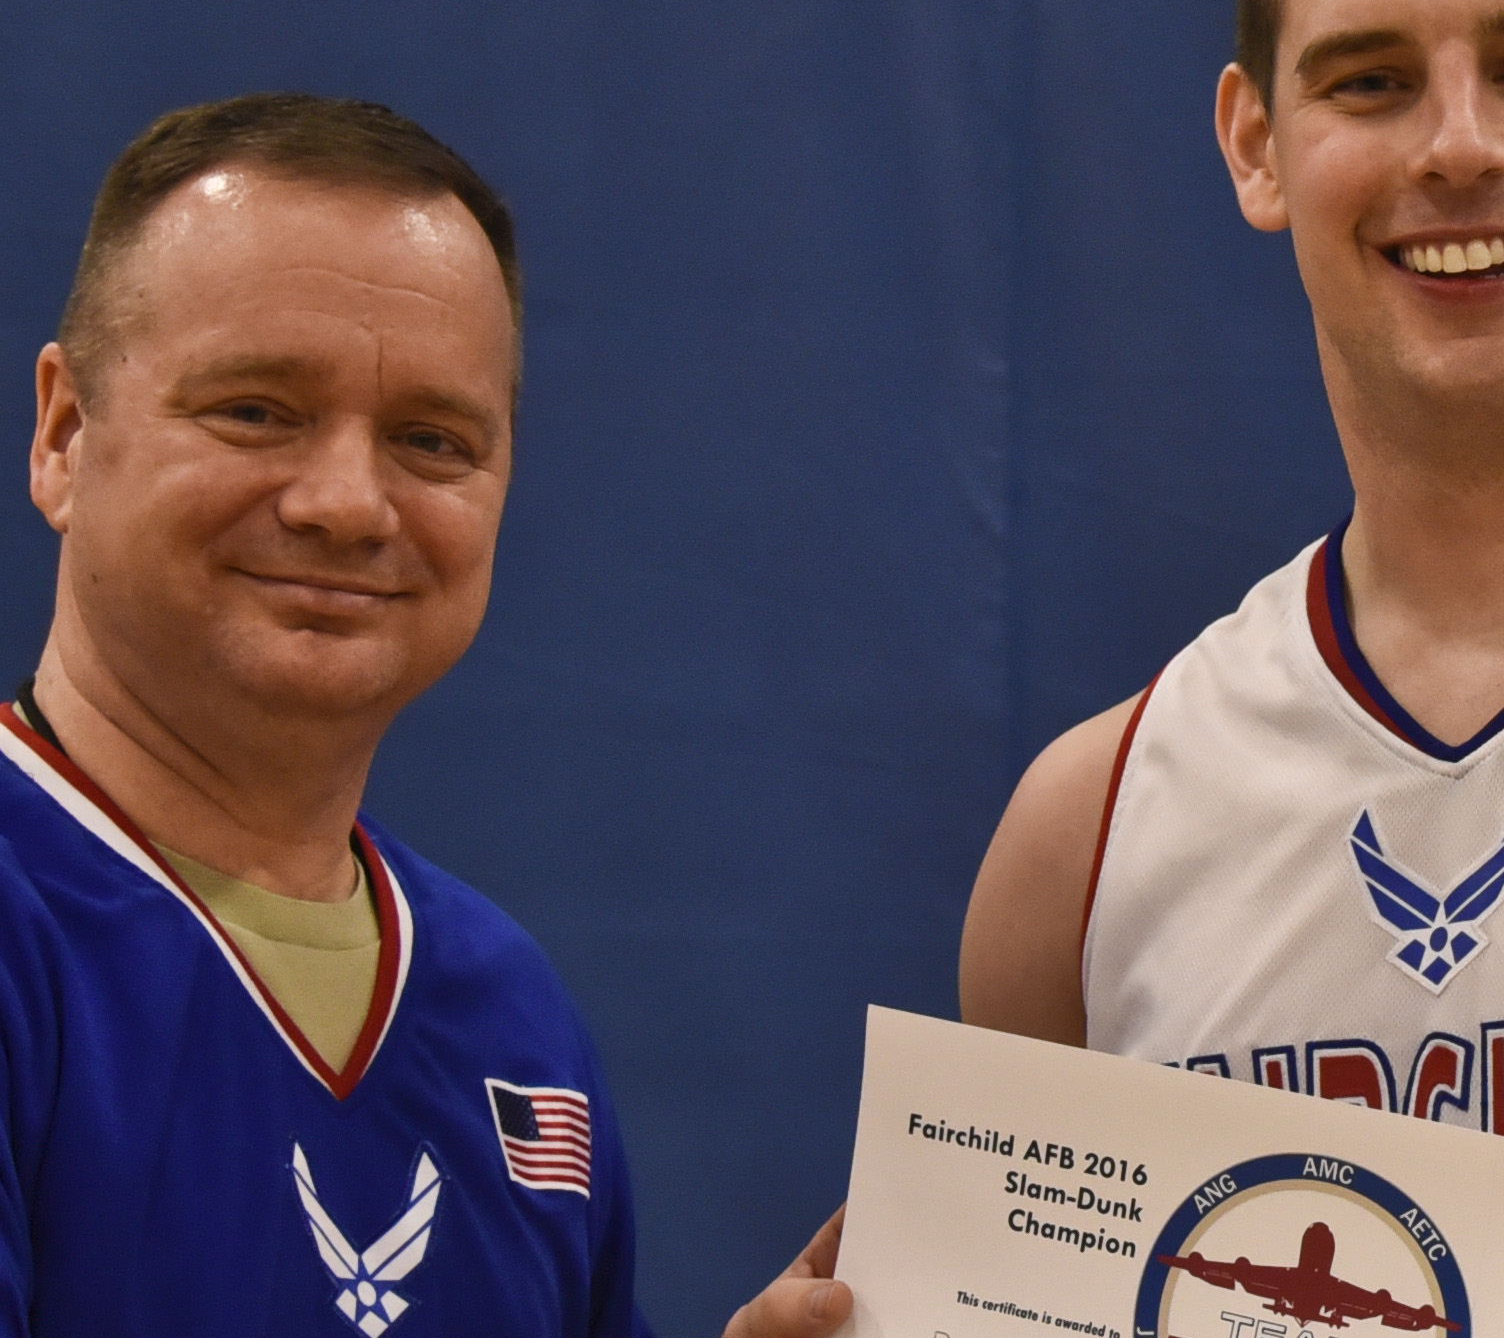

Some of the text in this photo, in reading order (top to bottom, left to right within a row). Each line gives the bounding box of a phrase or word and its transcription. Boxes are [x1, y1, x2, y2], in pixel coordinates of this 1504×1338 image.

[908, 1113, 1148, 1186] Fairchild AFB 2016
[1302, 1157, 1355, 1185] AMC
[1004, 1170, 1144, 1223] Slam-Dunk
[1193, 1173, 1238, 1214] ANG
[1007, 1208, 1137, 1259] Champion
[1399, 1208, 1447, 1261] AETC
[956, 1290, 979, 1308] This
[982, 1299, 1039, 1322] certificate
[1041, 1311, 1052, 1325] is
[1054, 1317, 1107, 1338] awarded
